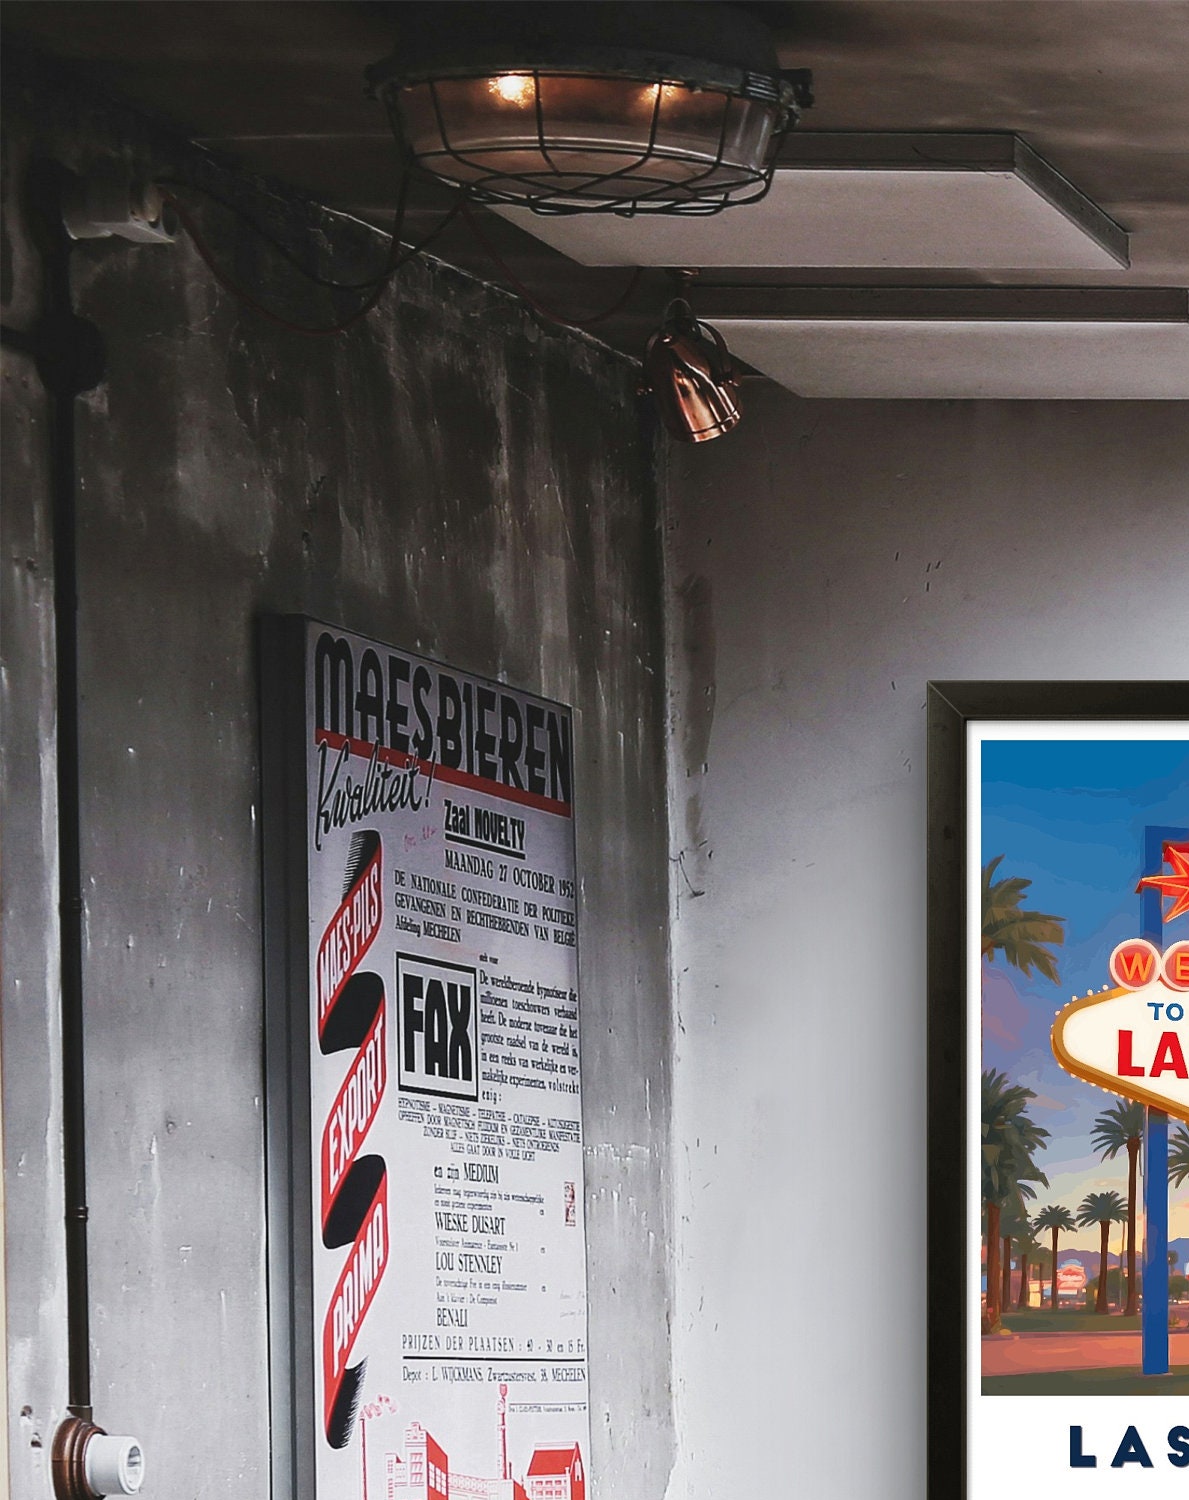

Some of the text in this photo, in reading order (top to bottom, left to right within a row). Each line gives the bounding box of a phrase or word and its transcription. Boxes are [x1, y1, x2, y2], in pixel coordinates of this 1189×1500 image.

[444, 800, 470, 836] Zaal
[445, 849, 493, 879] MAANDAG
[513, 867, 555, 895] OCTOBER
[394, 869, 406, 887] DE
[411, 874, 456, 899] NATIONALE
[461, 887, 519, 914] CONFEDERATIE
[523, 902, 537, 918] DER
[395, 892, 446, 918] GEVANGENEN
[451, 906, 461, 921] EN
[534, 925, 549, 941] VAN
[319, 861, 381, 1018] MAES-PILS
[423, 921, 461, 942] MECHELEN
[1148, 1002, 1184, 1021] TO
[402, 972, 473, 1082] FAX
[548, 1078, 579, 1094] volstrekt
[328, 1017, 384, 1193] EXPORT
[464, 1162, 499, 1184] MEDIUM
[472, 1215, 505, 1236] DUSART
[436, 1252, 454, 1271] LOU
[333, 1203, 384, 1377] PRIMA
[437, 1308, 468, 1327] BENALI
[402, 1334, 441, 1353] PRIJZEN
[446, 1336, 463, 1351] DER
[469, 1336, 514, 1352] PLAATSEN
